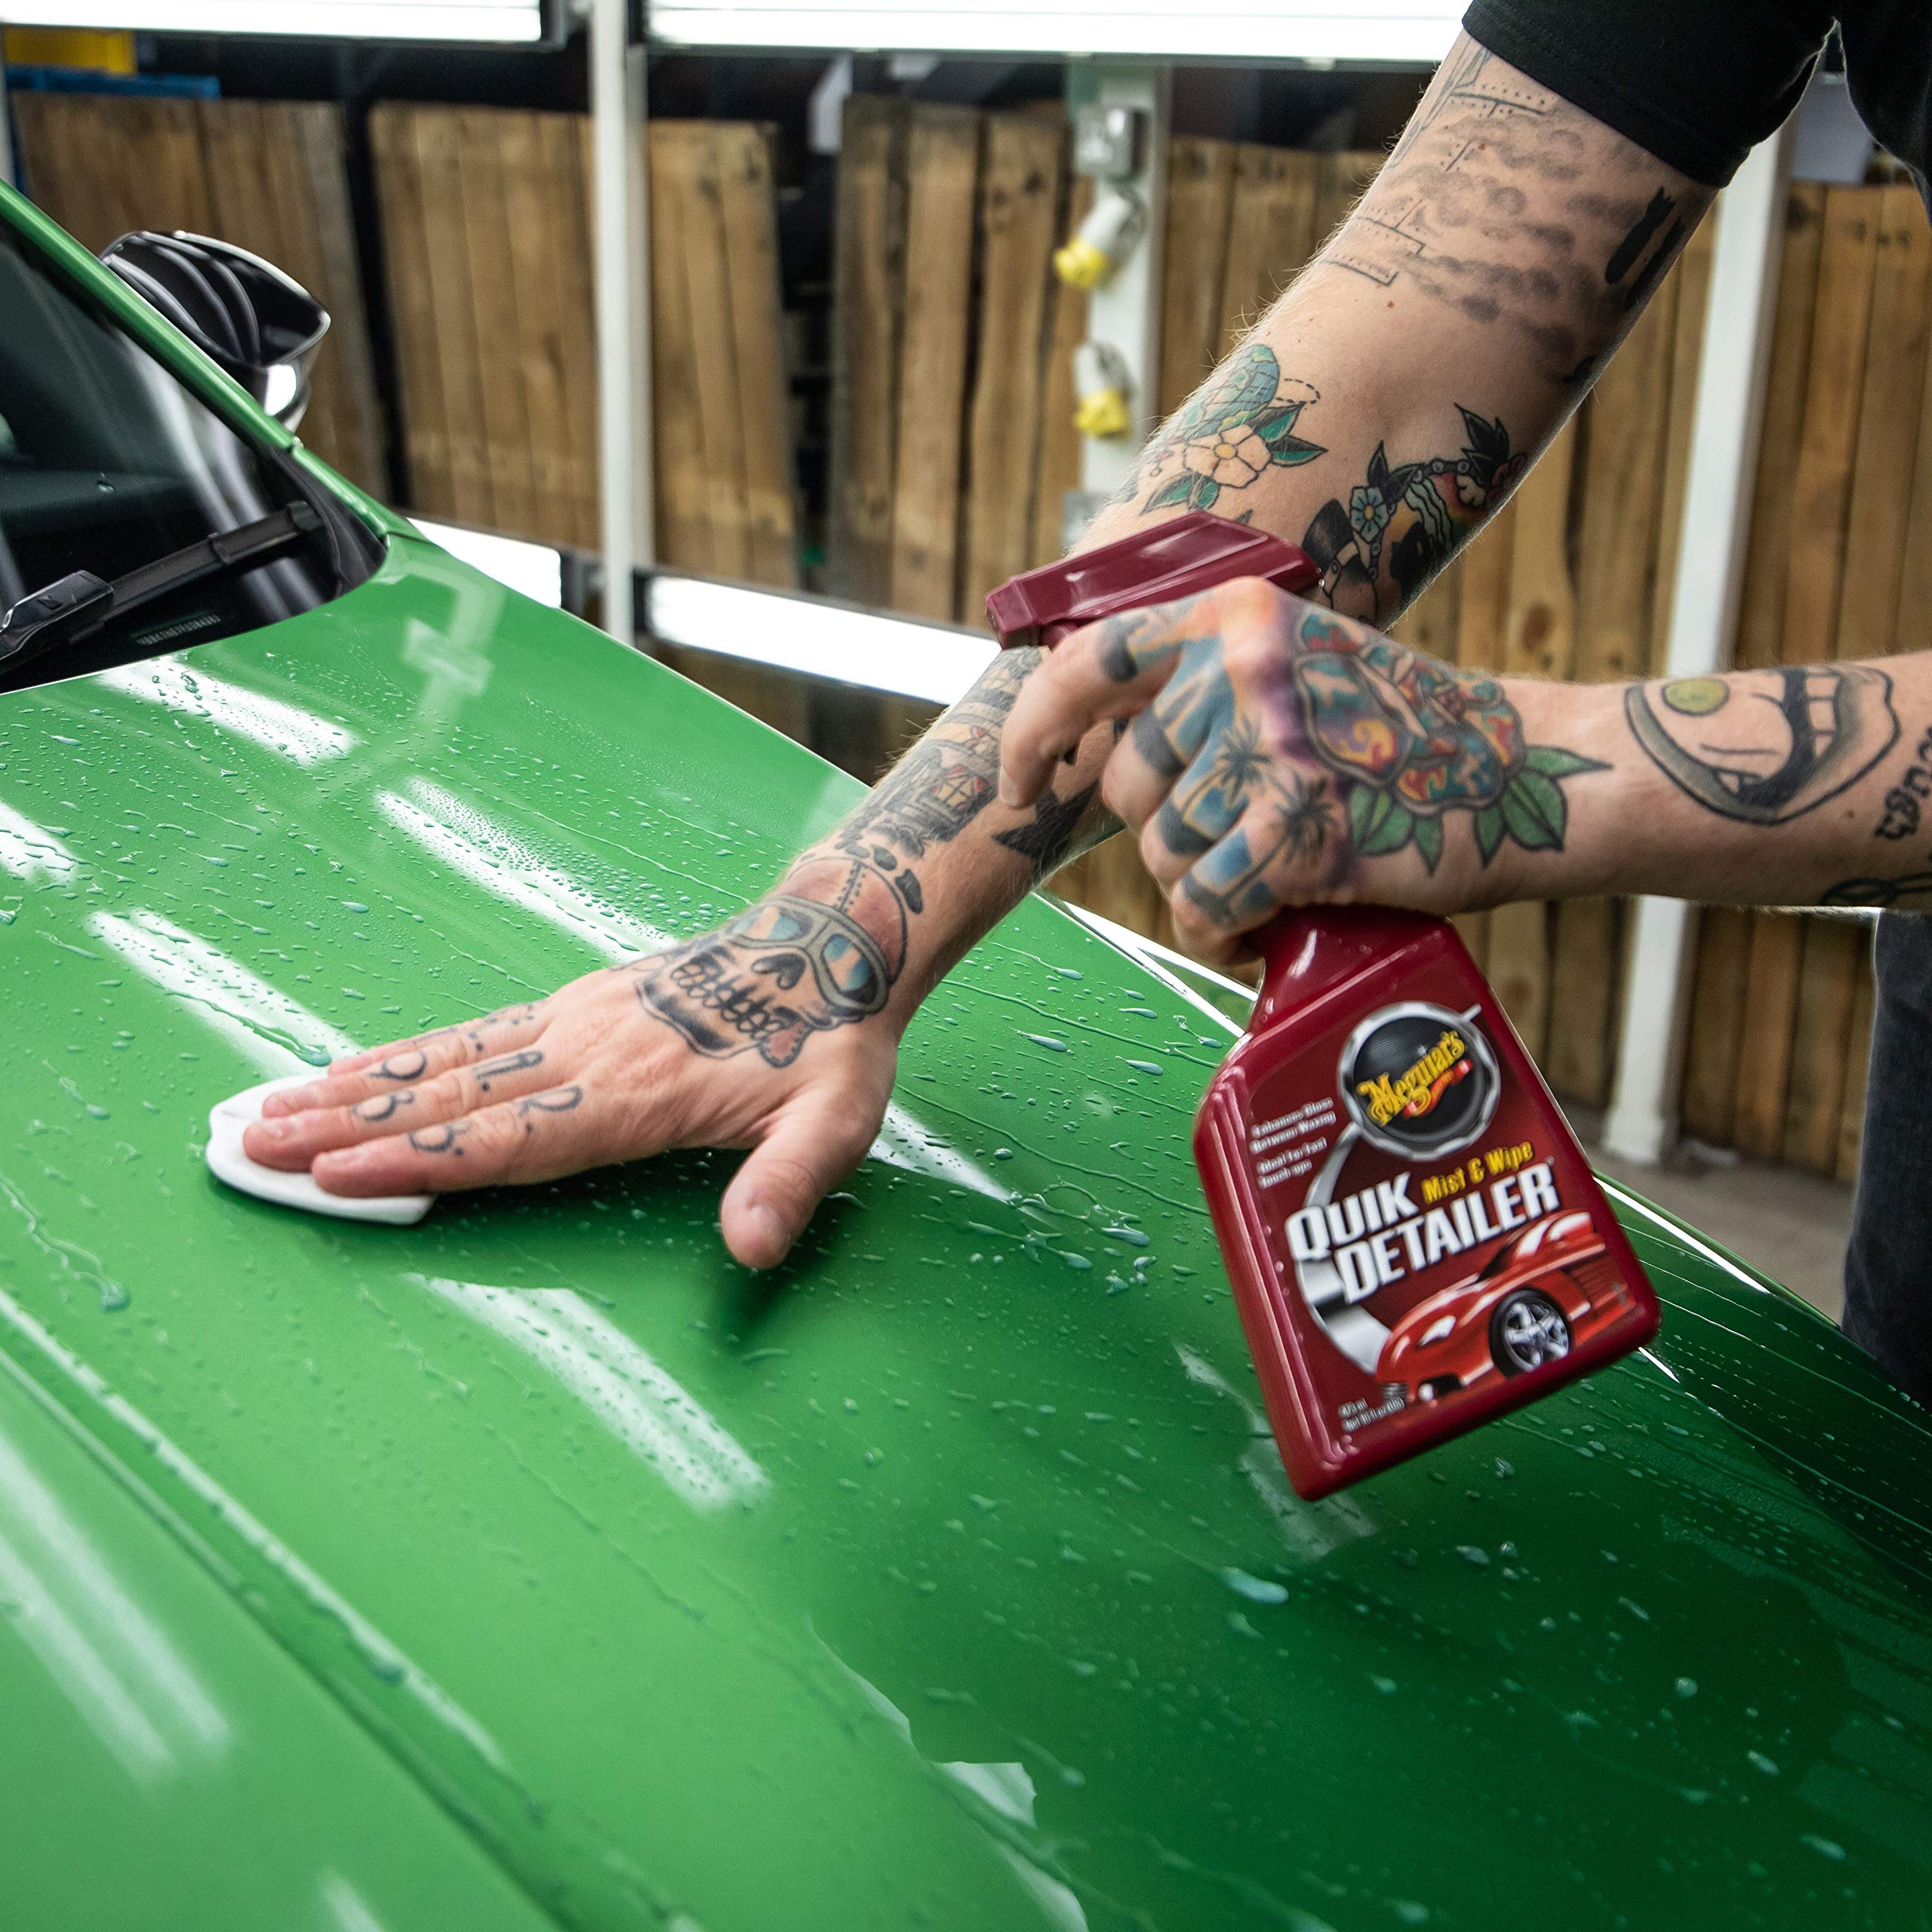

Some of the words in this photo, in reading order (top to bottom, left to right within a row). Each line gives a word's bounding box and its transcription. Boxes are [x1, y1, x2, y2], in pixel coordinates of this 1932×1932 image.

[1285, 1171, 1420, 1262] QUIK
[1421, 1168, 1466, 1204] Mist
[1467, 1157, 1485, 1184] &
[1484, 1141, 1535, 1176] Wipe
[1333, 1162, 1561, 1304] DETAILER
